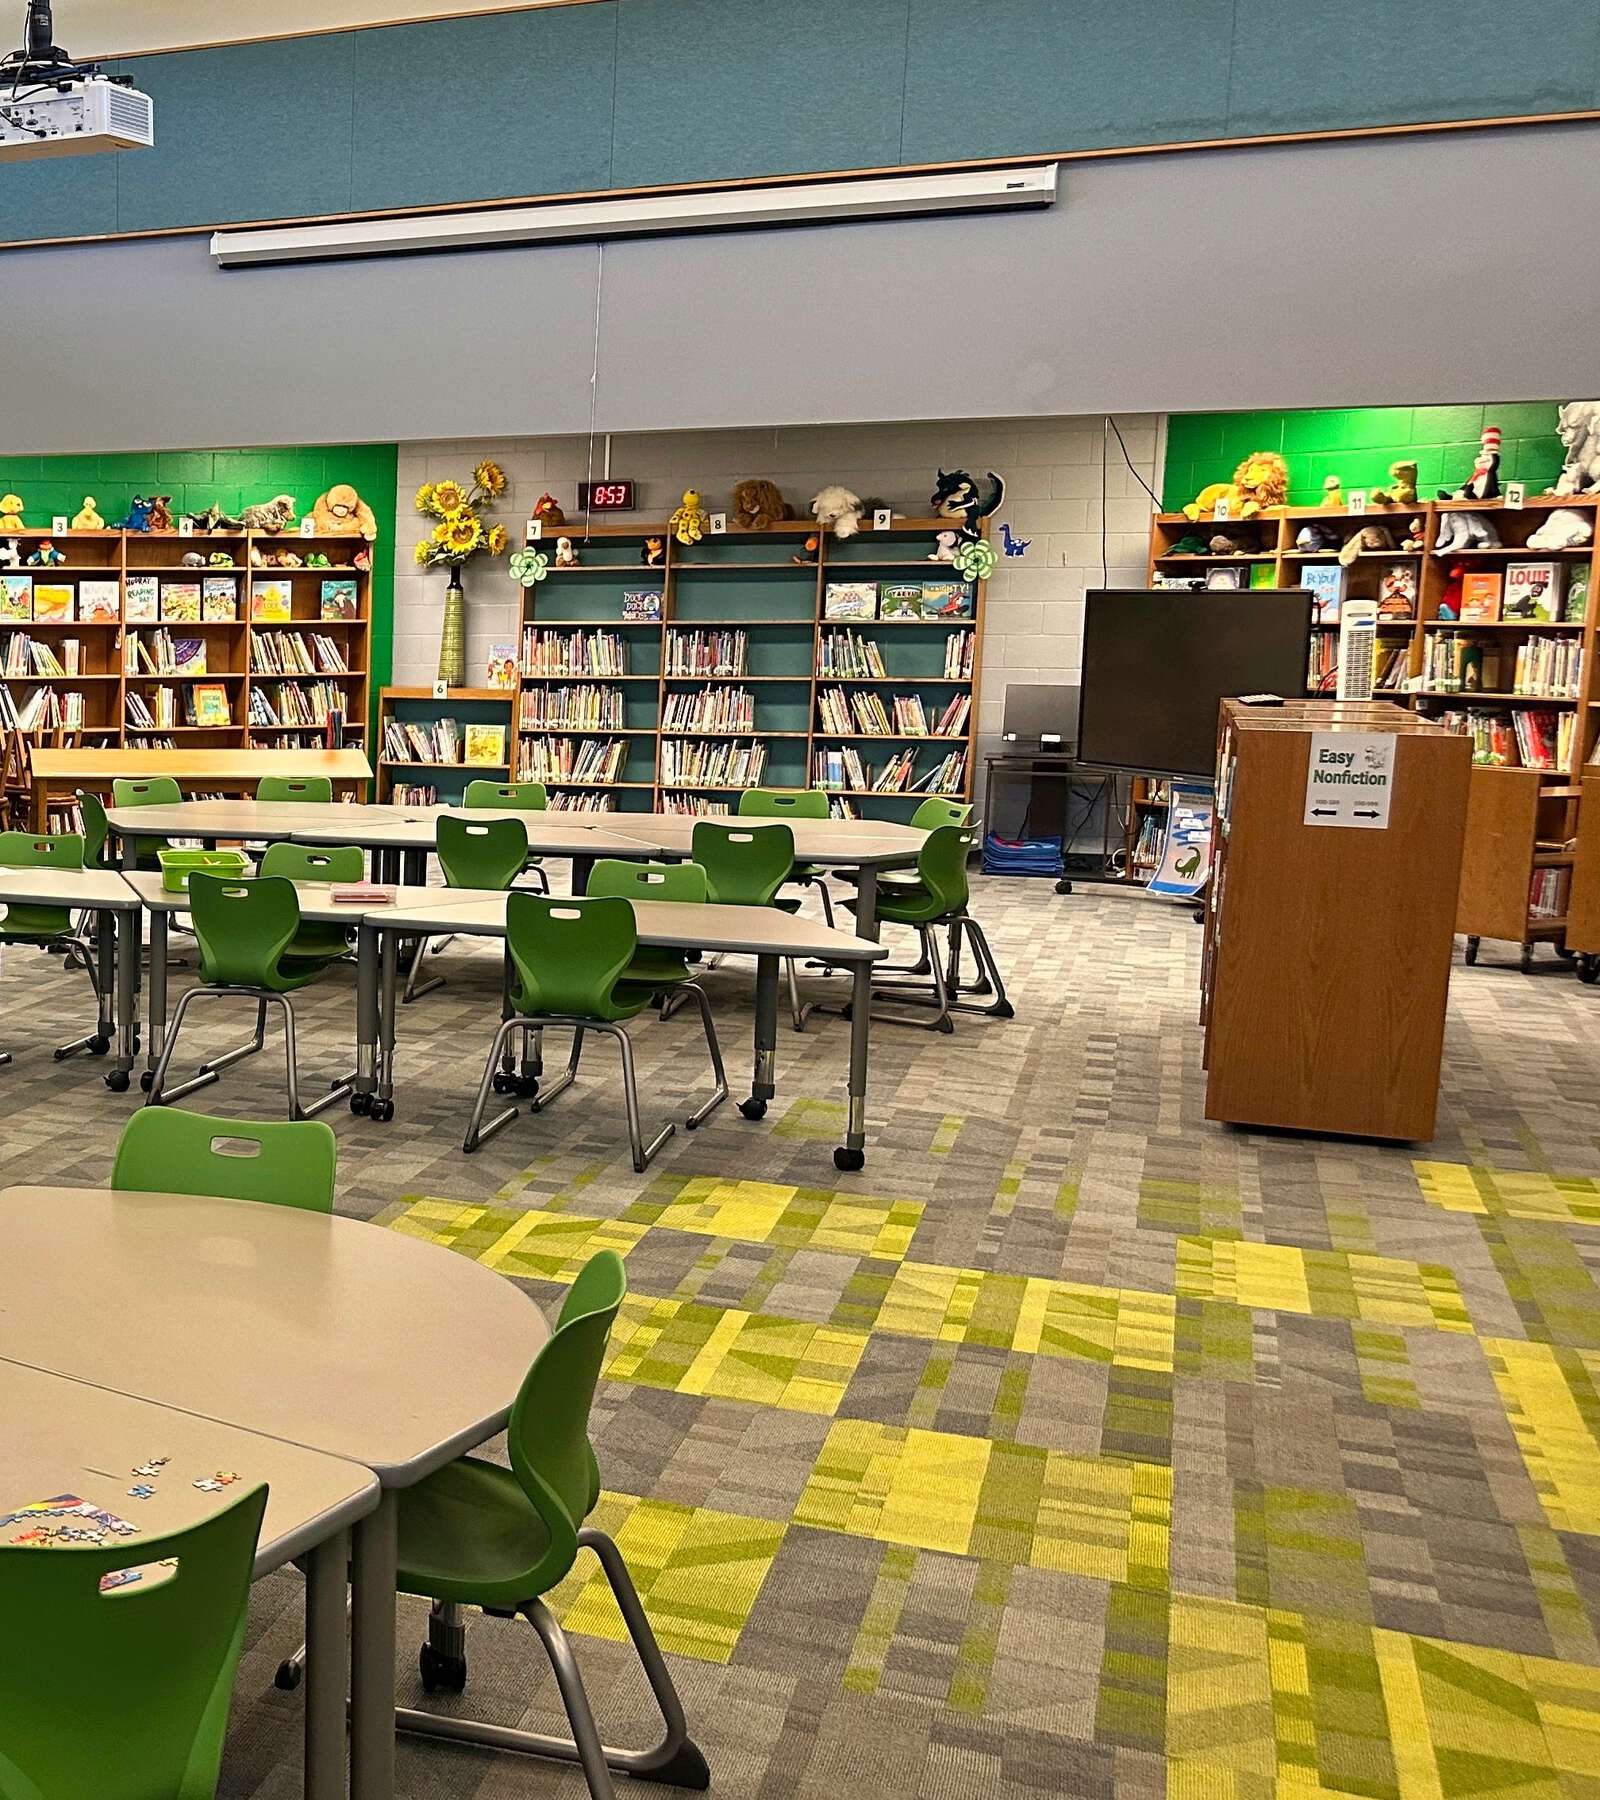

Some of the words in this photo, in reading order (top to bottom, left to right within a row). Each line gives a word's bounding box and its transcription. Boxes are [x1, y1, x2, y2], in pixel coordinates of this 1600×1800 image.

[595, 486, 626, 504] 8:53
[1508, 490, 1520, 503] 12
[1352, 497, 1361, 510] 11
[1217, 505, 1227, 516] 10
[714, 519, 721, 529] 8
[878, 514, 886, 524] 9
[57, 522, 63, 532] 3
[183, 523, 188, 533] 4
[304, 524, 310, 533] 5
[530, 526, 537, 535] 7
[437, 685, 444, 694] 6
[1319, 749, 1355, 768] Easy
[1313, 769, 1387, 785] Nonfiction
